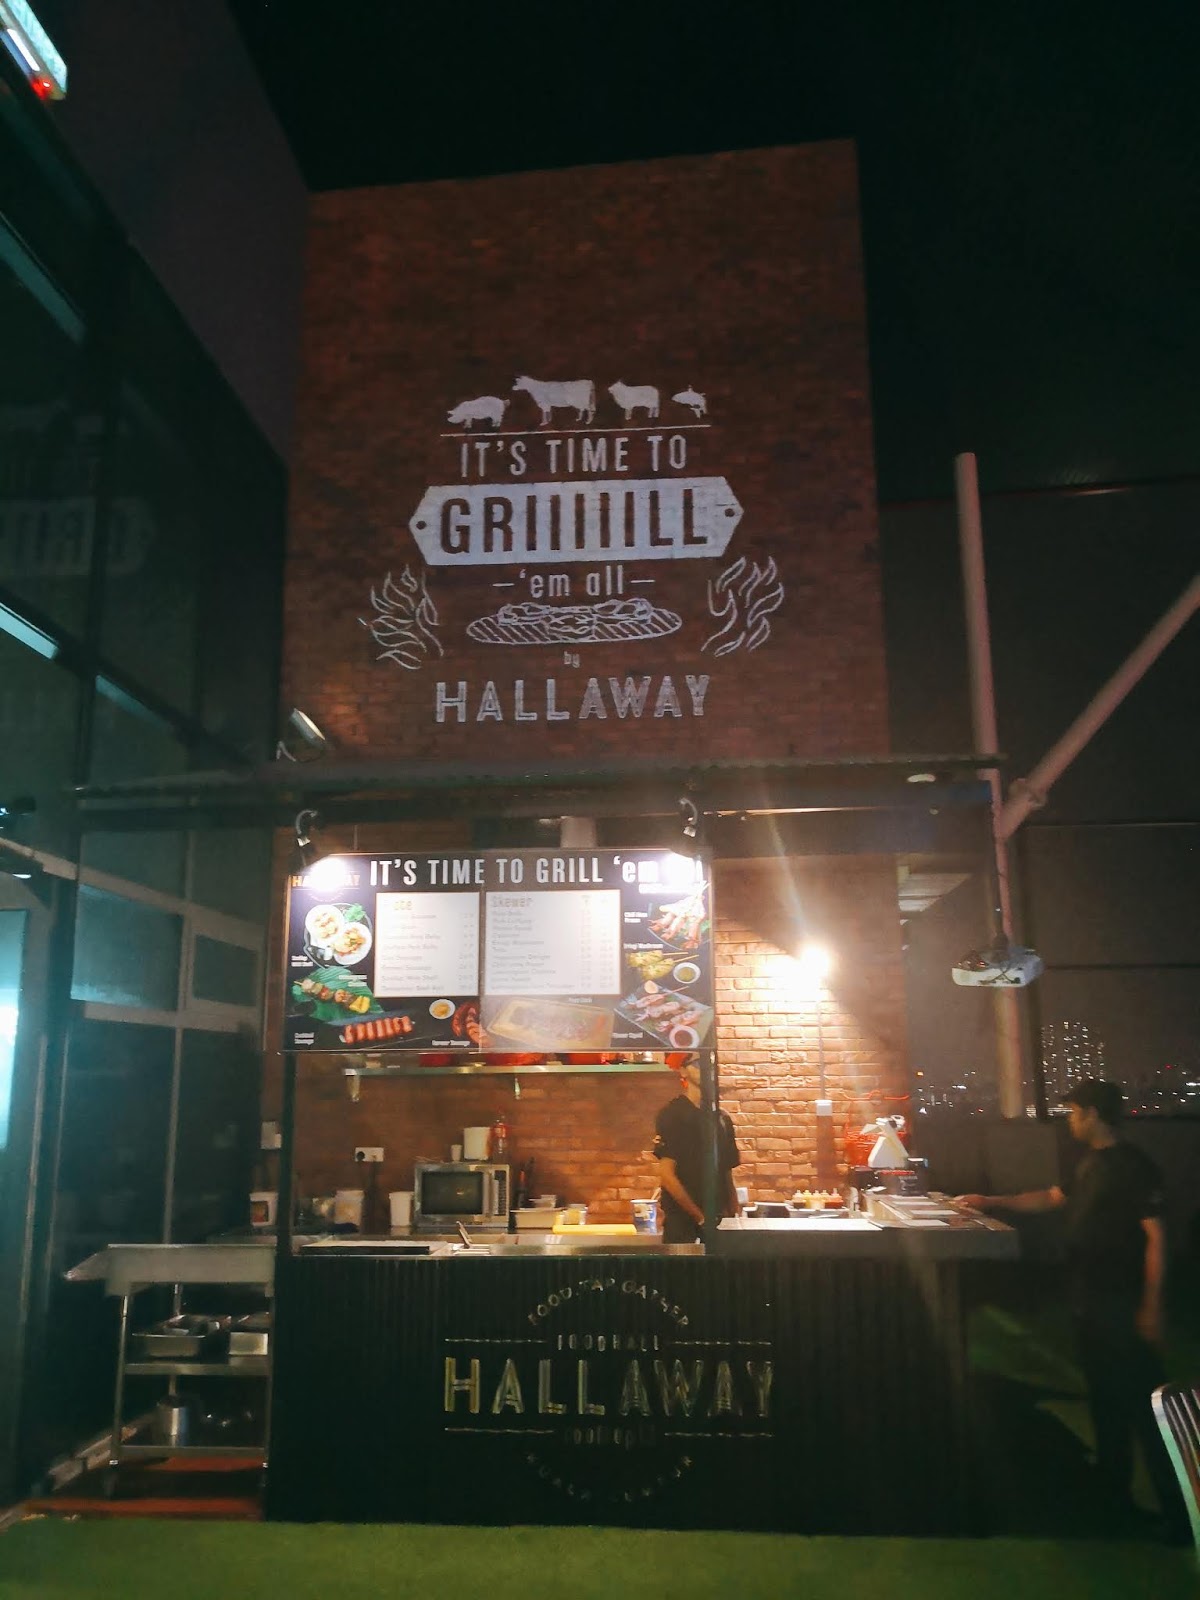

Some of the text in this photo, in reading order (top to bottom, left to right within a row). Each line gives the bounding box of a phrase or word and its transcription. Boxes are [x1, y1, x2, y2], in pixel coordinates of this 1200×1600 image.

[460, 434, 687, 478] IT'S TIME TO
[586, 565, 623, 596] all
[435, 674, 710, 722] HALLAWAY
[369, 859, 417, 886] IT'S
[428, 858, 485, 885] TIME
[496, 858, 524, 885] TO
[536, 857, 603, 883] GRILL
[444, 1356, 774, 1417] HALLAWAY
